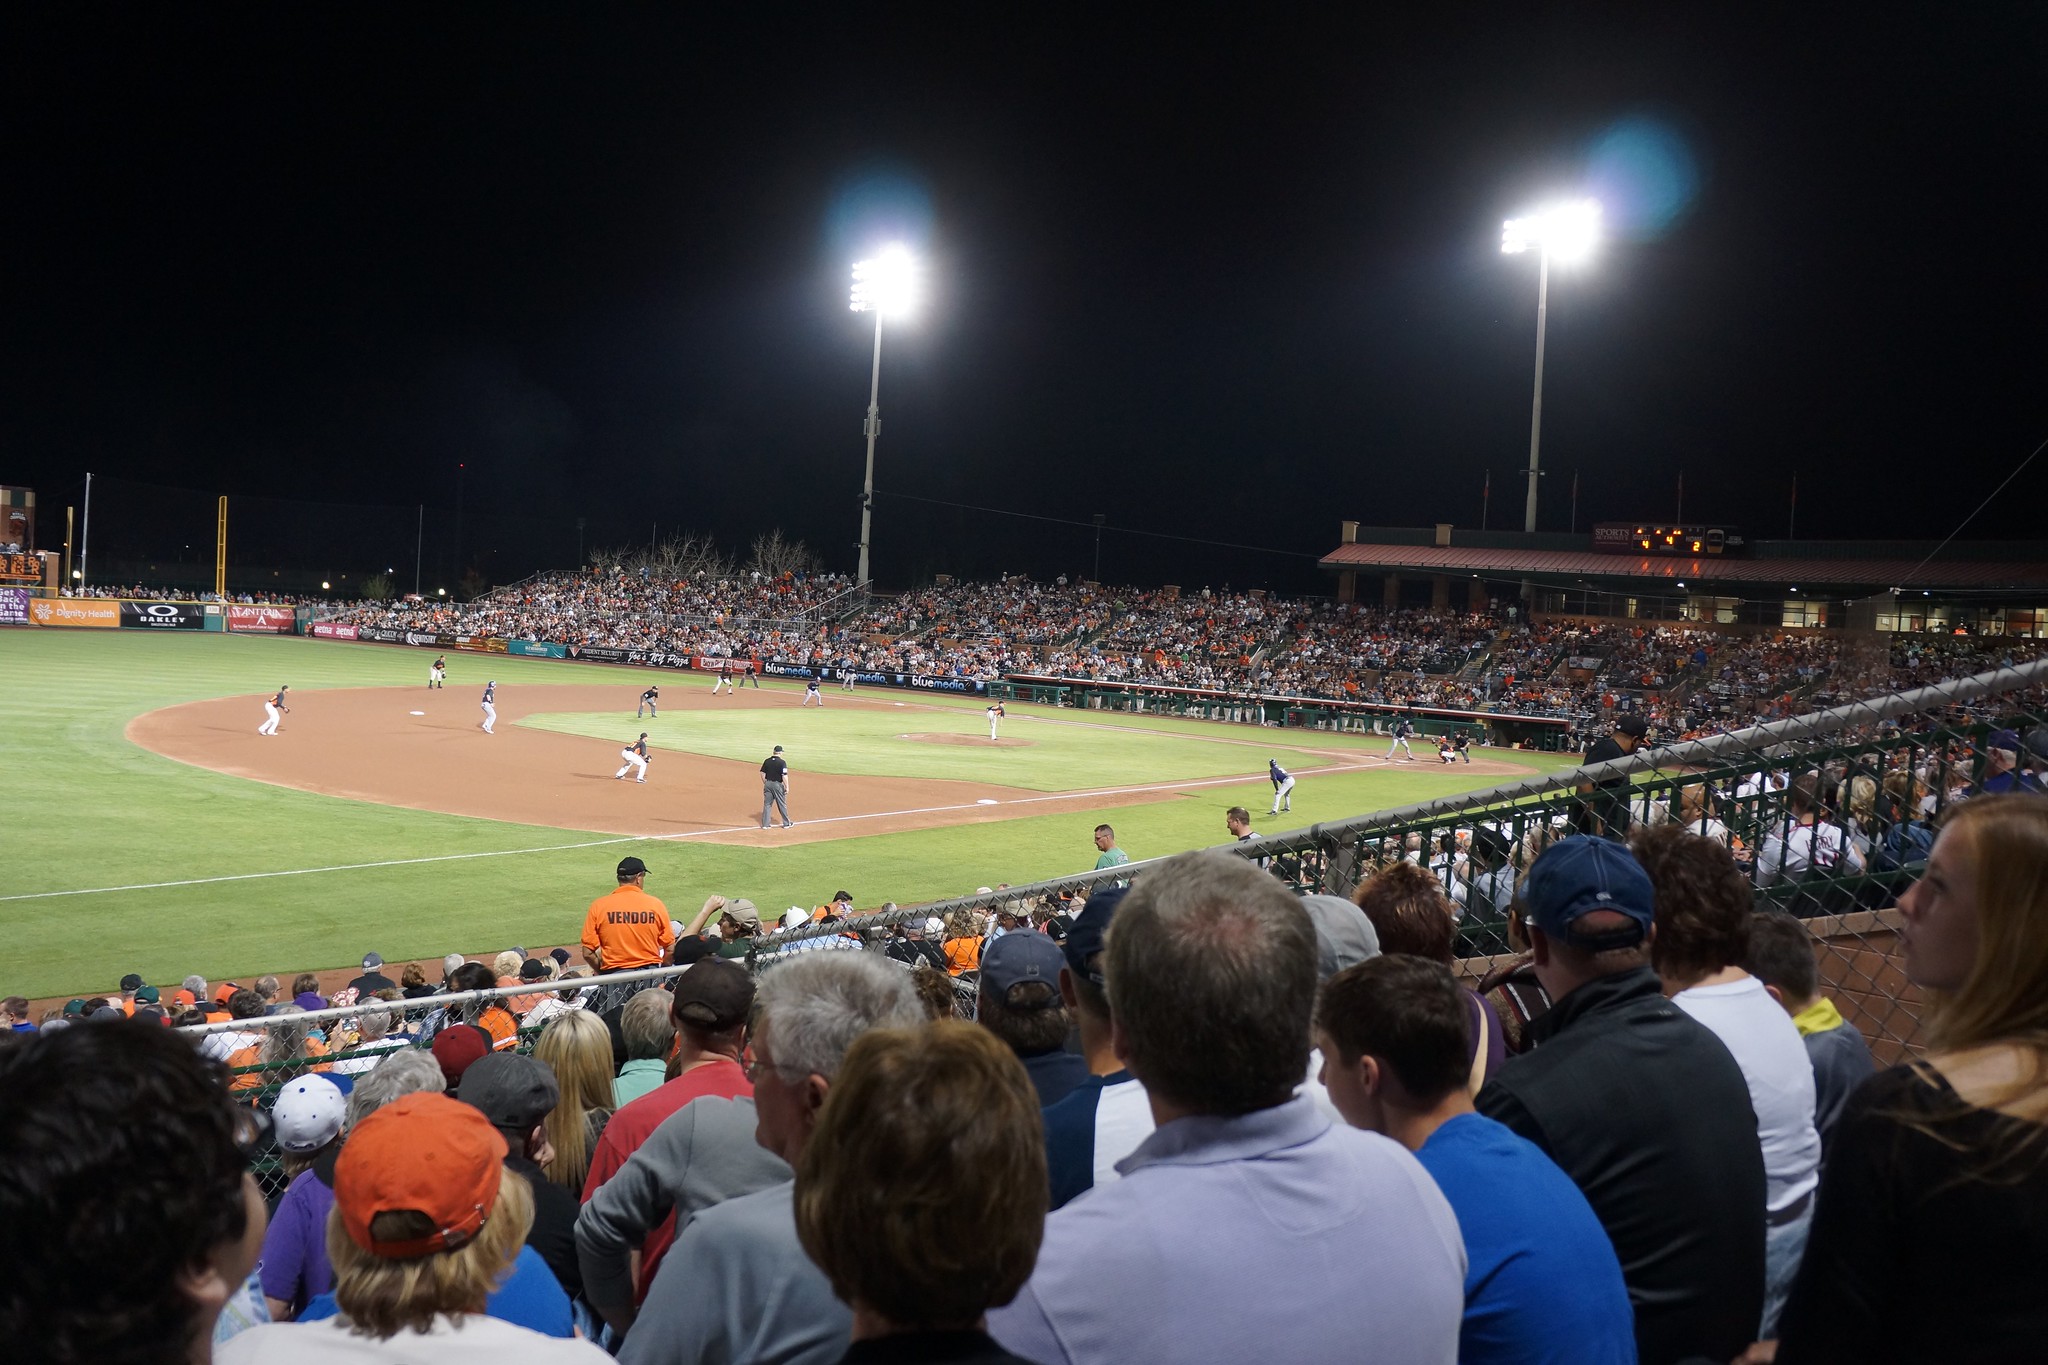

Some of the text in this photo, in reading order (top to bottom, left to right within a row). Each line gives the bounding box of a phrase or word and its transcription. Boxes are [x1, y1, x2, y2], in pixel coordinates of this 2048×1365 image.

[1595, 528, 1630, 537] SPORTS
[1642, 540, 1649, 549] 4
[1666, 536, 1673, 545] 4
[1693, 541, 1701, 551] 2
[8, 602, 25, 610] the
[56, 608, 115, 619] Dignity Health
[314, 625, 333, 634] aetna
[336, 627, 354, 637] aetna
[628, 651, 647, 662] Joe's
[650, 653, 665, 665] NY
[667, 655, 689, 667] Pizza
[765, 662, 812, 676] bluemedia
[836, 669, 886, 683] blemedia
[912, 675, 965, 690] bluemedia
[607, 911, 655, 924] VENDOR
